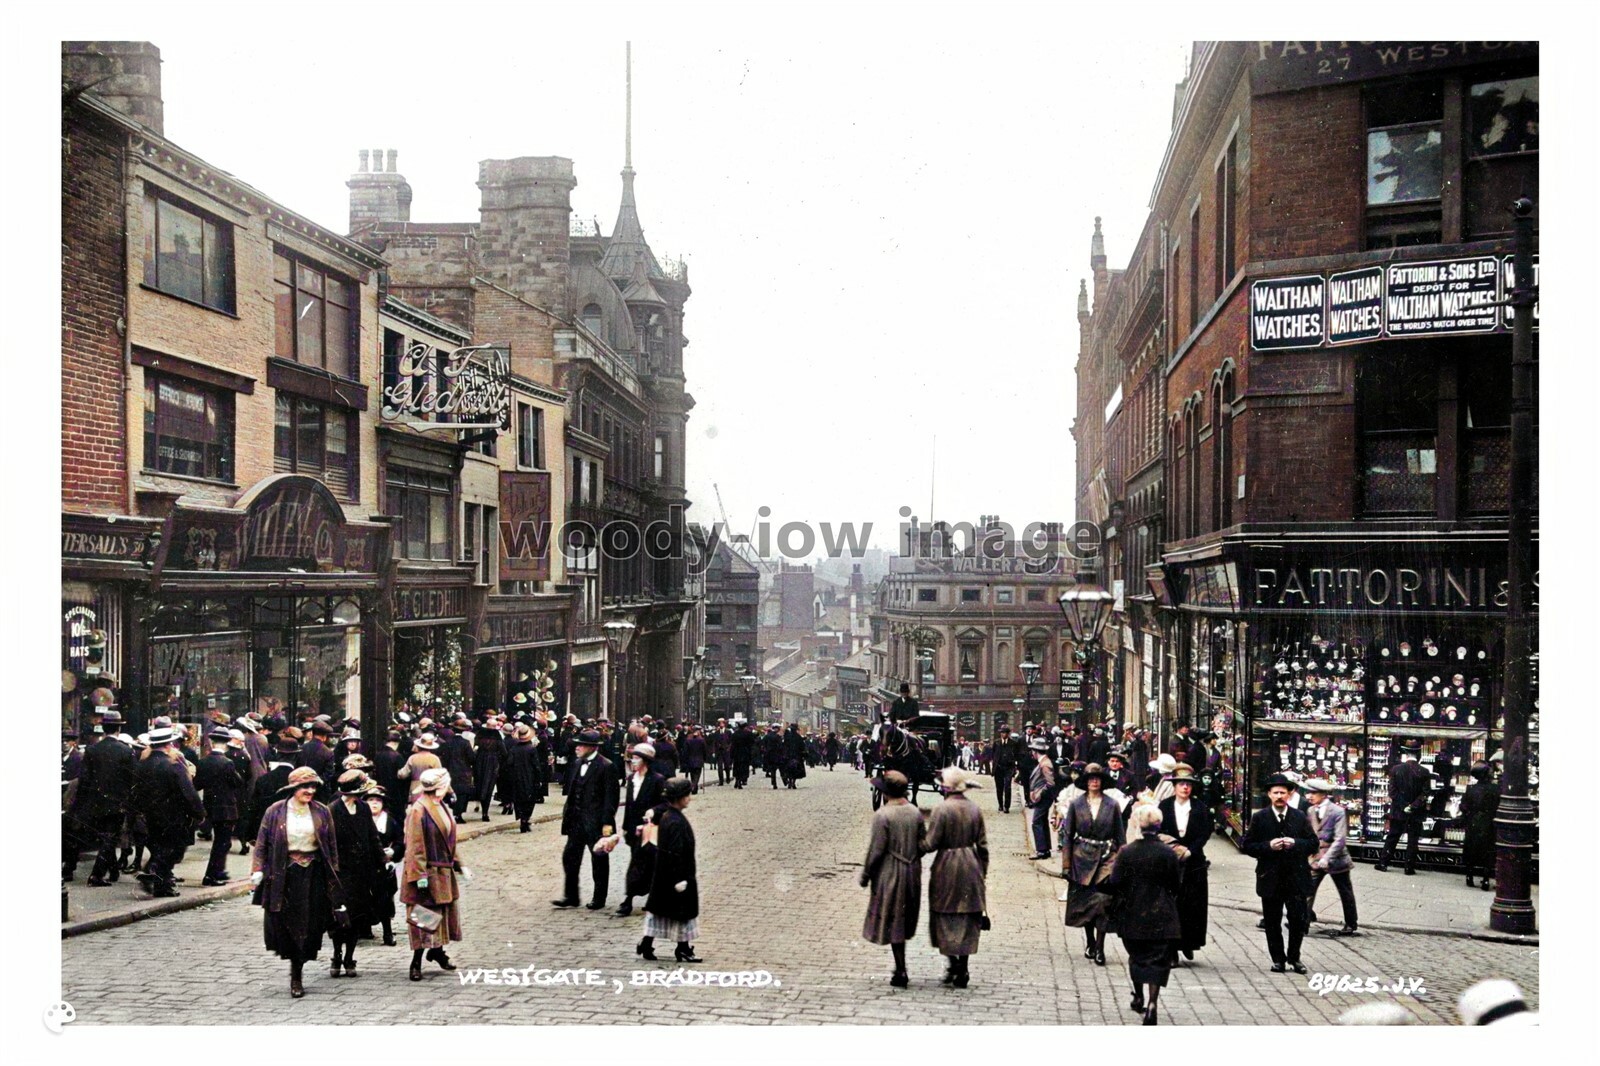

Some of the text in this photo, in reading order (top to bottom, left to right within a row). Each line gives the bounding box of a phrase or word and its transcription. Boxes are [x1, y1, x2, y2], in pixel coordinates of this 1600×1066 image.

[1318, 57, 1351, 74] 27
[1389, 266, 1438, 285] FATTORINI
[1439, 267, 1447, 281] &
[1449, 263, 1476, 281] SONS
[1449, 282, 1470, 290] FOR
[1254, 284, 1323, 312] WALTHAM
[1330, 275, 1381, 305] WALTHAM
[1388, 293, 1440, 321] WALTHAM
[1441, 290, 1496, 317] WATCHES
[1254, 313, 1323, 340] WATCHES.
[1330, 306, 1382, 335] WATCHES.
[1389, 323, 1402, 331] THE
[1404, 321, 1432, 330] WORLD'S
[1434, 320, 1455, 328] WATCH
[1457, 318, 1476, 326] OVER
[381, 379, 508, 421] Gledhill
[953, 558, 1011, 573] WALLER
[1254, 568, 1486, 606] FATTORINI
[413, 589, 466, 618] GLEDHILL
[511, 617, 555, 642] GLEDHILL
[70, 646, 89, 658] HATS
